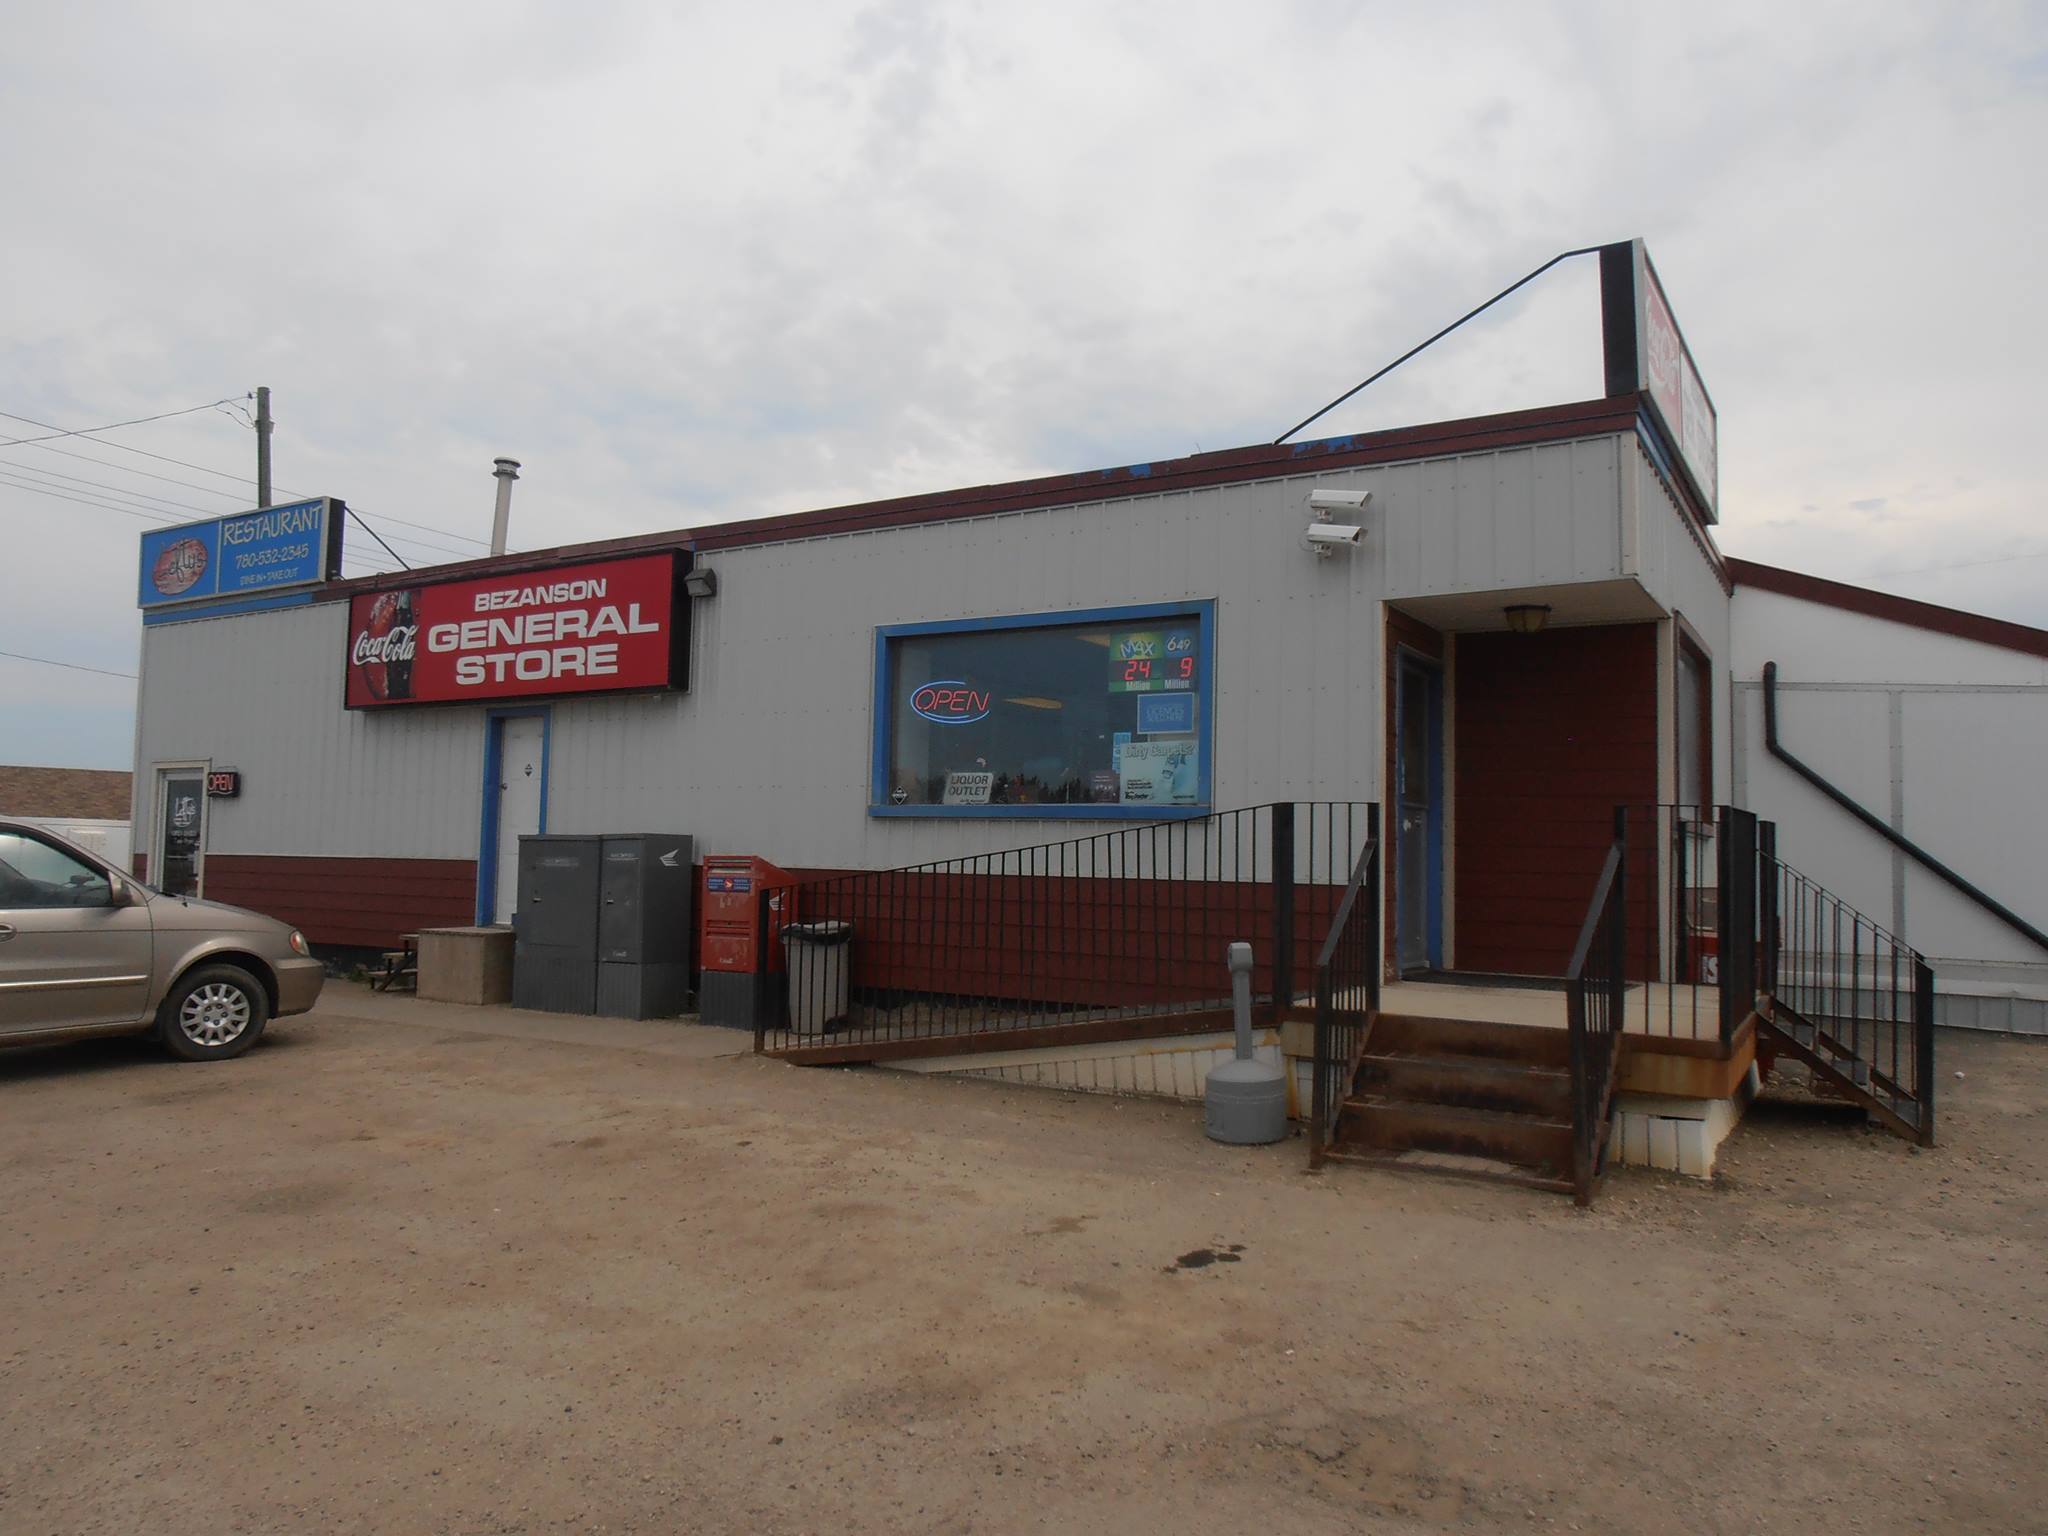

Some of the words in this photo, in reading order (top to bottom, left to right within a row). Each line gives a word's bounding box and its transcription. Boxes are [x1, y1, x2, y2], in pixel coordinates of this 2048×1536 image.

[223, 505, 322, 546] RESTAURANT
[475, 578, 607, 612] BEZANSON
[428, 603, 660, 654] GENERAL
[1120, 639, 1155, 658] MAX
[456, 643, 619, 685] STORE
[1124, 660, 1151, 680] 24
[1179, 657, 1193, 678] 9
[1164, 679, 1190, 689] Million
[914, 688, 991, 712] OPEN
[207, 773, 234, 791] OPEN
[951, 775, 989, 784] LIQUOR
[949, 786, 987, 795] OUTLET
